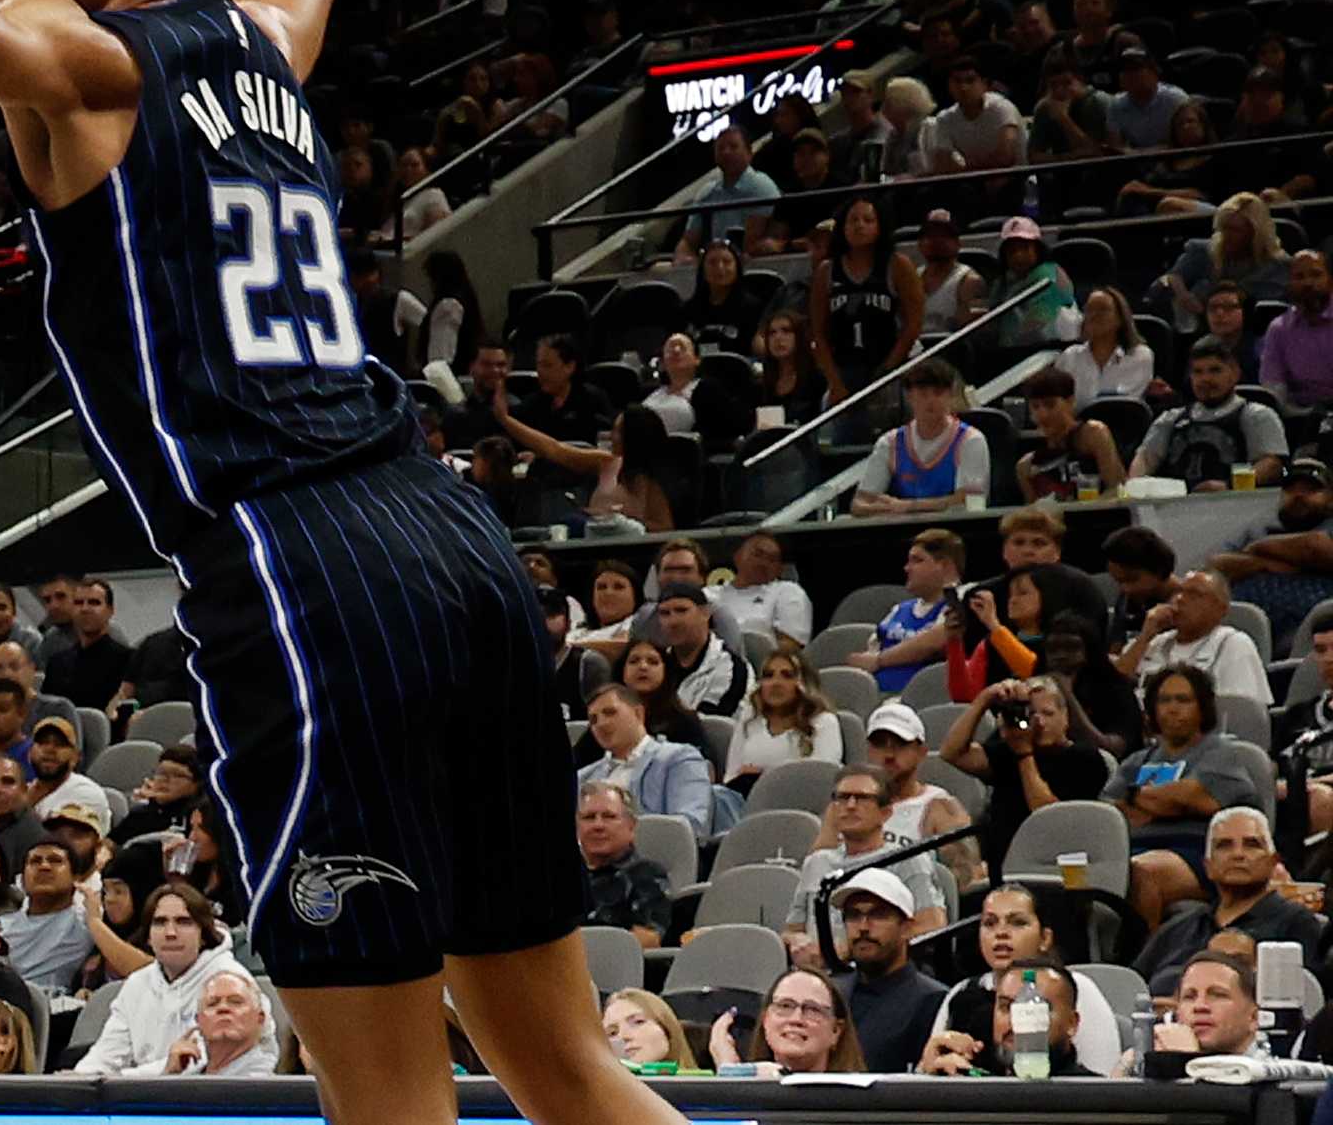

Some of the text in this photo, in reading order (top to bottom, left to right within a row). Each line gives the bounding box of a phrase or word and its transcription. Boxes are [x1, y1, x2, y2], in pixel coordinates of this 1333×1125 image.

[180, 69, 315, 164] DA SILVA
[665, 74, 745, 113] WATCH
[208, 176, 366, 370] 23
